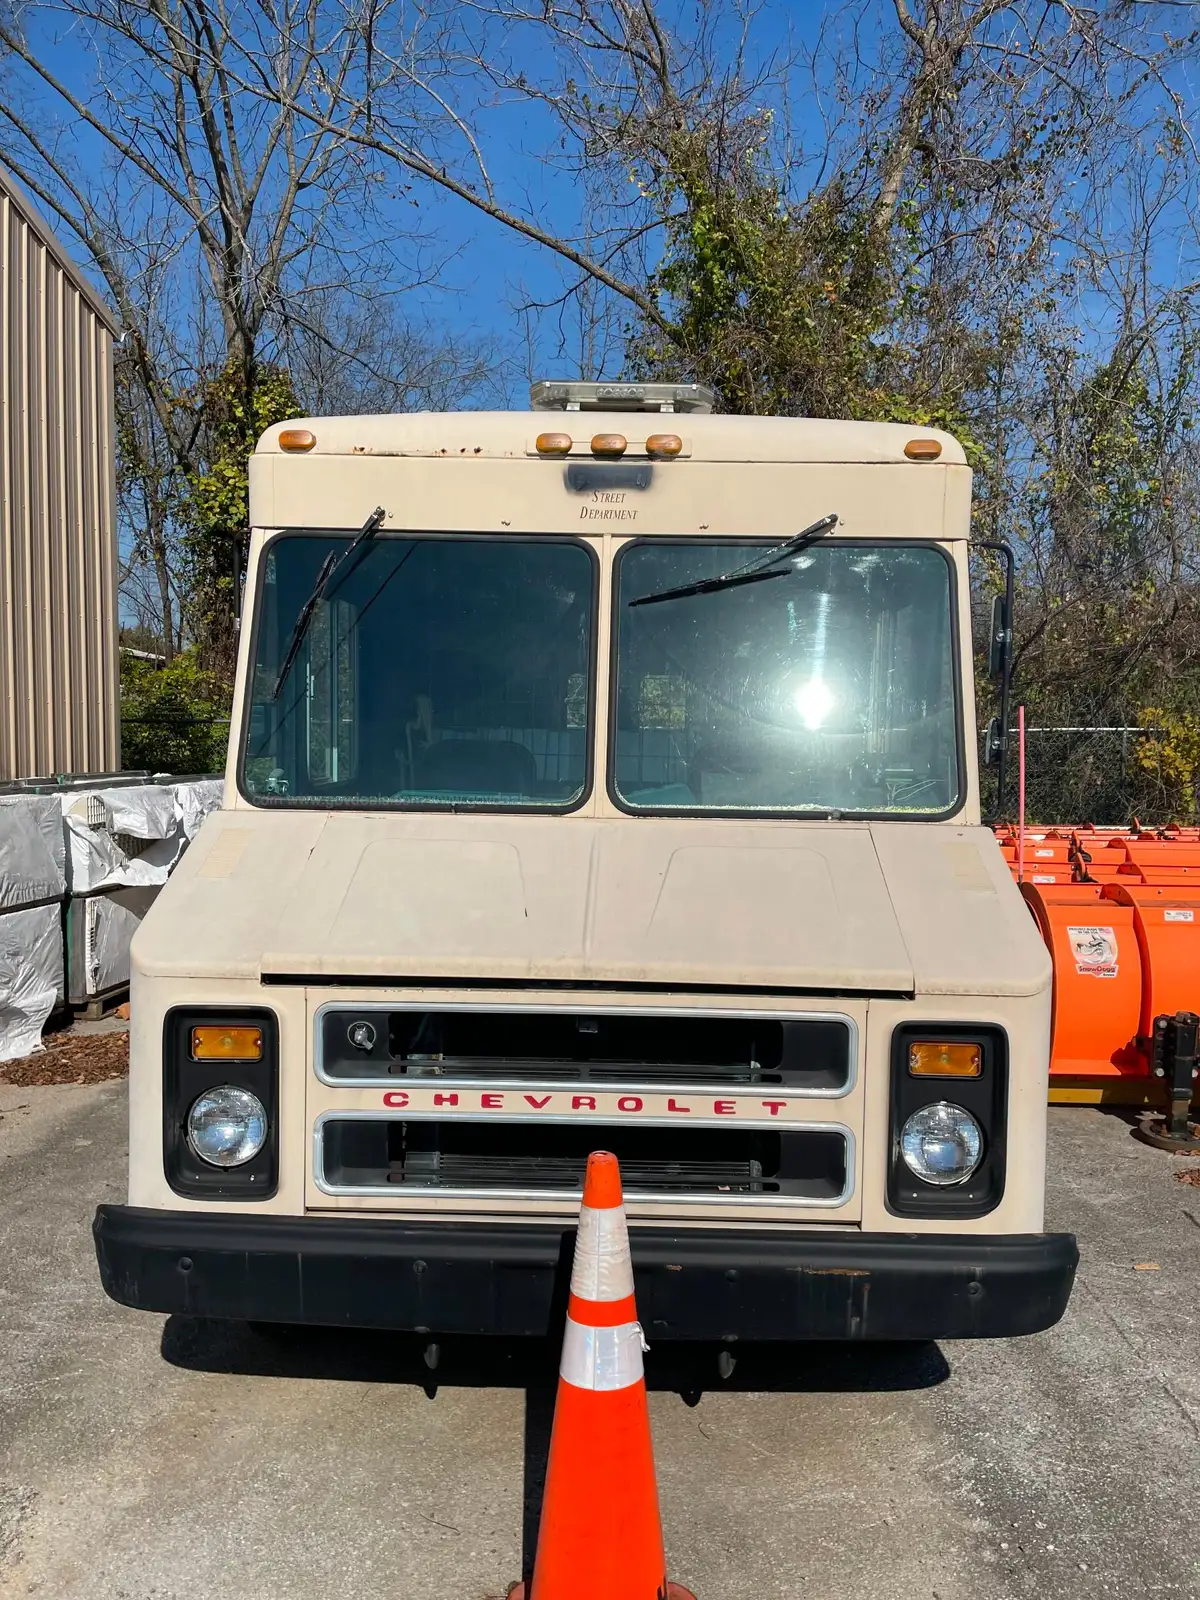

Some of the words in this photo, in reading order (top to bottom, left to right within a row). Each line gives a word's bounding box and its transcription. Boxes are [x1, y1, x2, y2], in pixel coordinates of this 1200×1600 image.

[592, 490, 626, 503] STREET
[580, 506, 638, 520] DEPARTMENT
[382, 1092, 787, 1116] CHEVROLET
